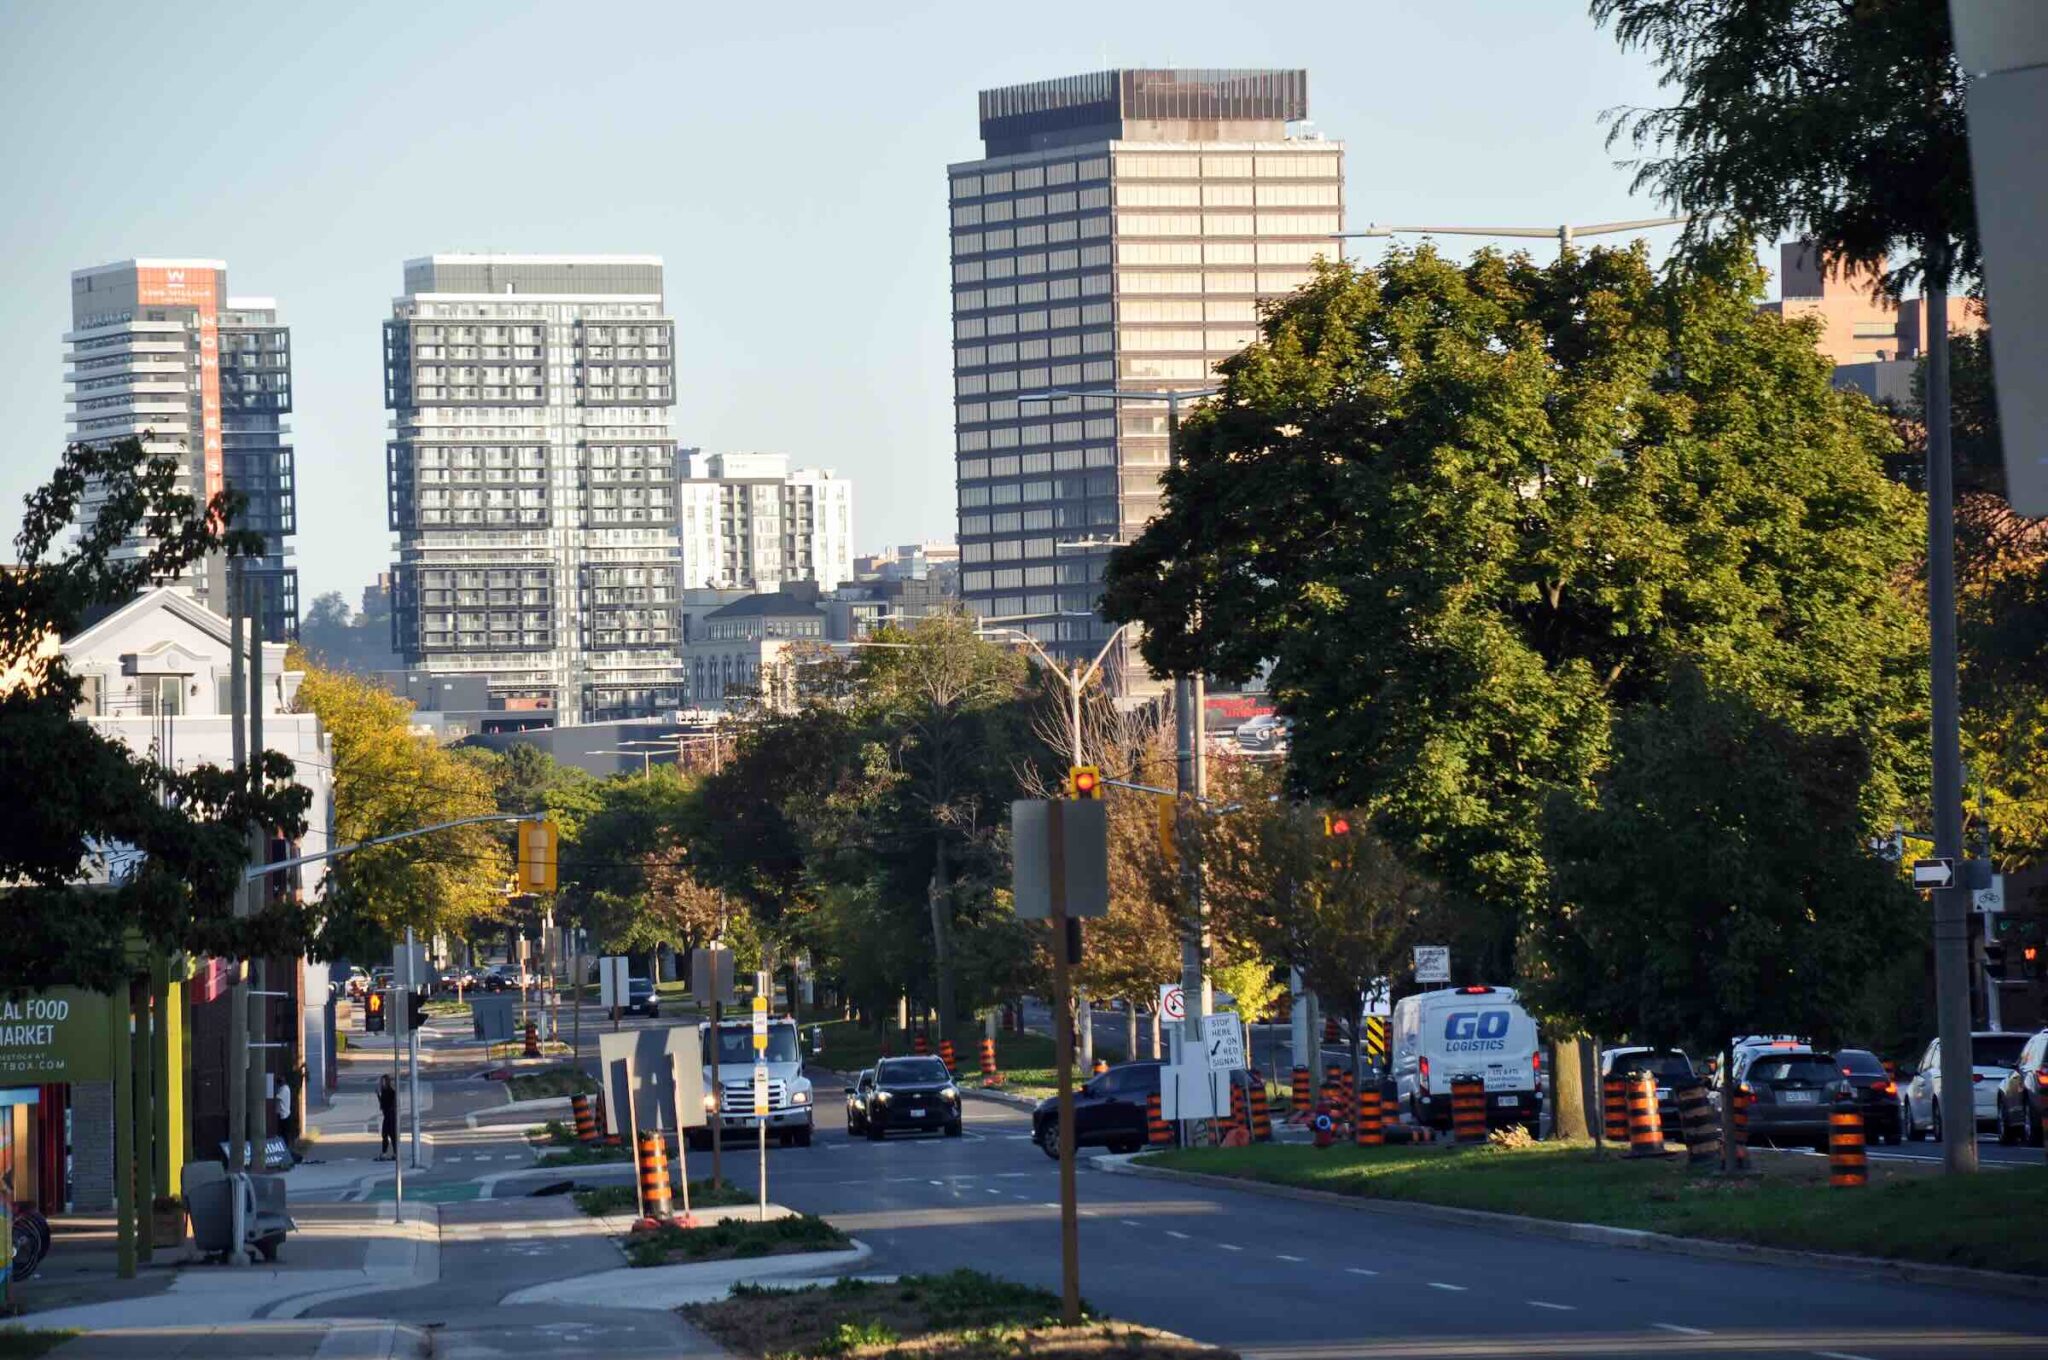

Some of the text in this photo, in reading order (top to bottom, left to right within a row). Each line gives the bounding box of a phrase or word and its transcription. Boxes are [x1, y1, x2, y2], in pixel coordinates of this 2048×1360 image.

[0, 999, 69, 1021] AL FOOD
[1211, 1018, 1230, 1027] STOP
[1444, 1010, 1510, 1040] GO
[1211, 1027, 1231, 1036] HERE
[1226, 1036, 1237, 1045] ON
[1223, 1046, 1238, 1055] RED
[1446, 1040, 1505, 1052] LOGISTICS
[1212, 1056, 1239, 1066] SIGNAL
